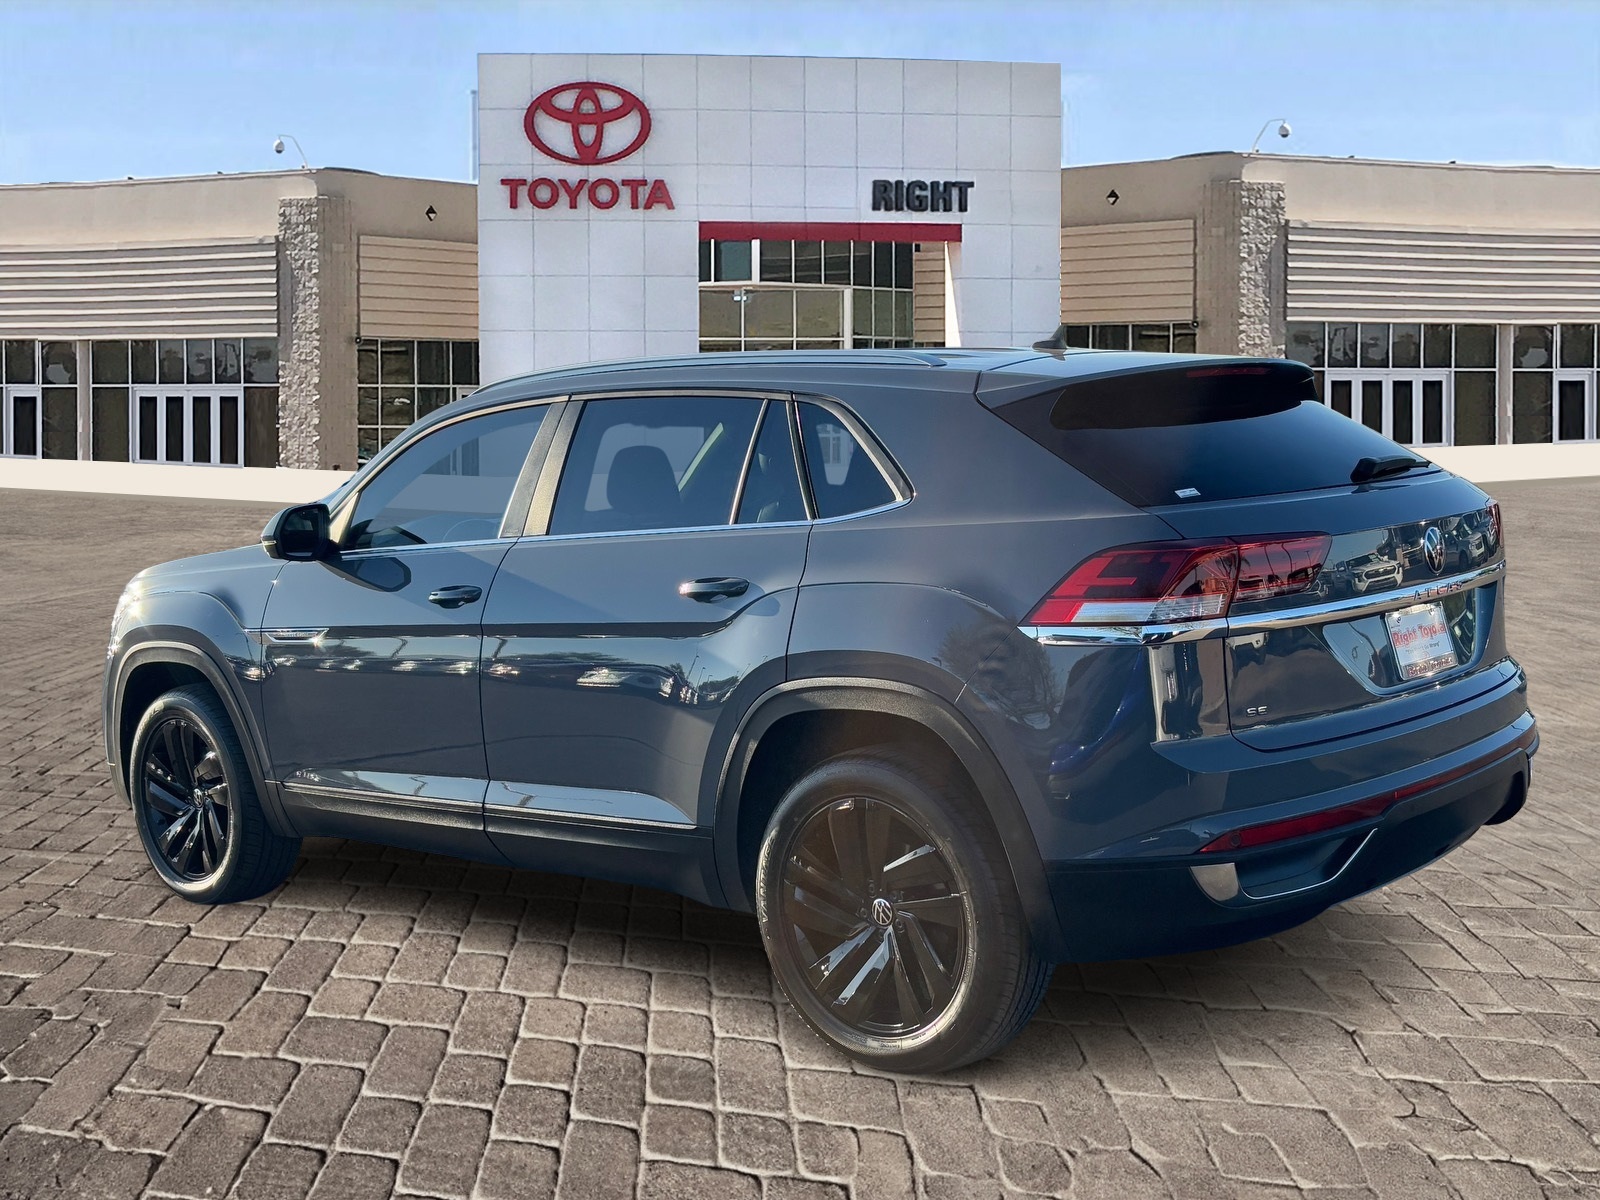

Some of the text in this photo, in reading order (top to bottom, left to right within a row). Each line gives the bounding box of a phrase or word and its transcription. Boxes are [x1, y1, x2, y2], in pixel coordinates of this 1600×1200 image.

[500, 178, 675, 210] TOYOTA
[872, 179, 974, 212] RIGHT
[1414, 582, 1463, 600] ATLAS
[1392, 629, 1417, 647] Right
[1246, 705, 1267, 717] SE
